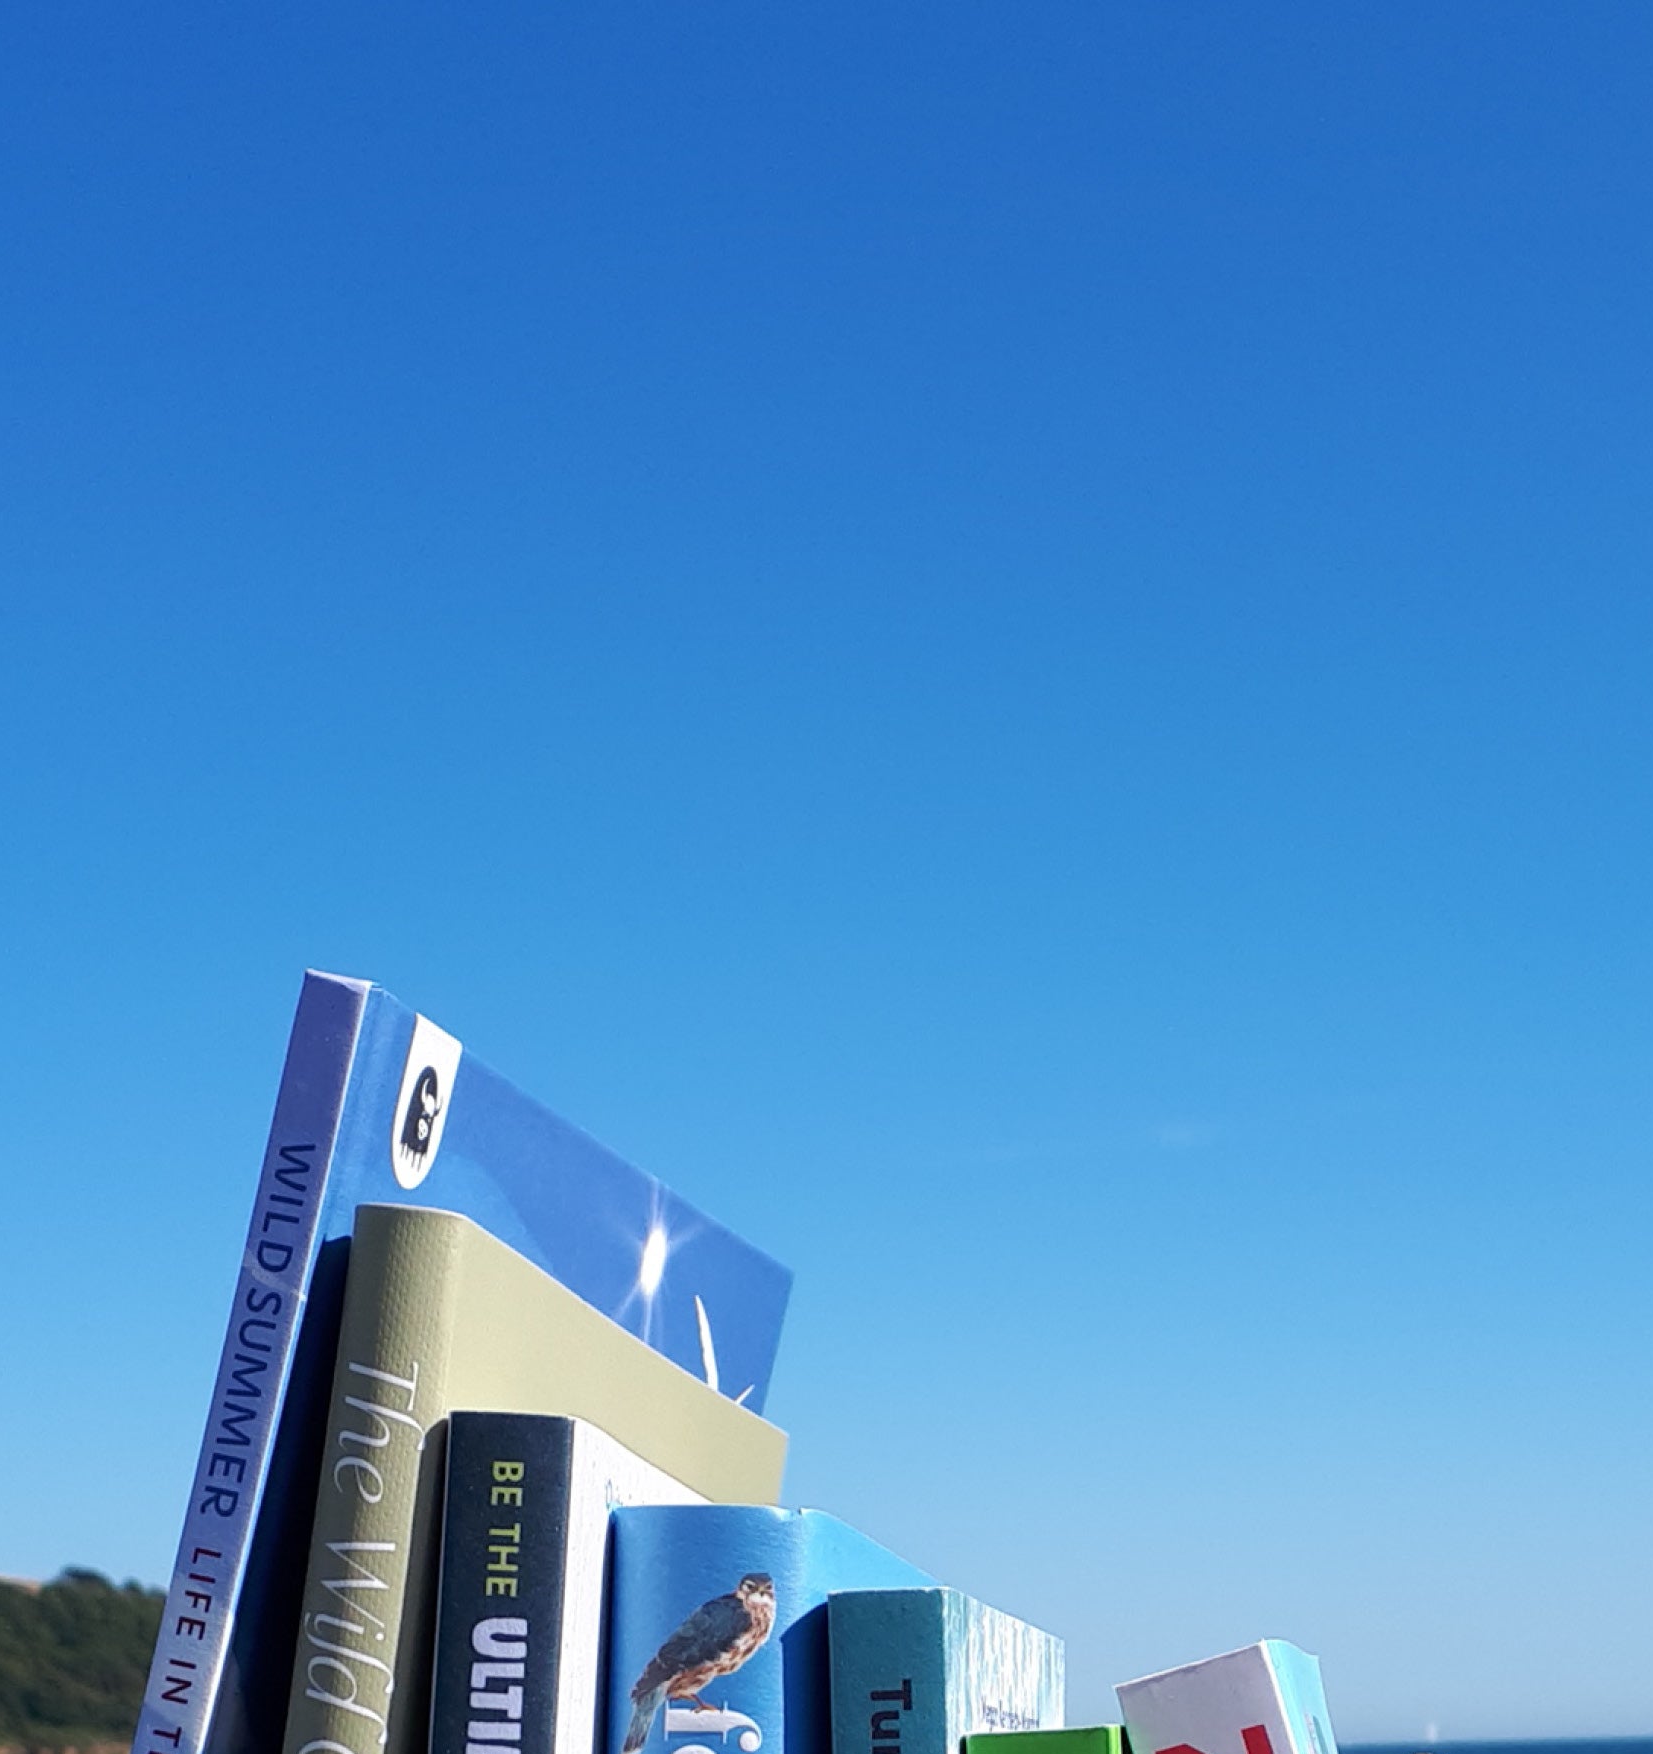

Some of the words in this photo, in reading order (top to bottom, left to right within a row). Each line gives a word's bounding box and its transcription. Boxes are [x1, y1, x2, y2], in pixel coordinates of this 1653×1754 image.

[257, 1144, 316, 1273] WILD
[200, 1287, 282, 1517] SUMMER
[334, 1361, 425, 1504] The
[491, 1460, 525, 1507] BE
[176, 1546, 222, 1640] LIFE
[486, 1522, 521, 1598] THE
[161, 1658, 197, 1705] IN
[301, 1540, 396, 1744] Wild
